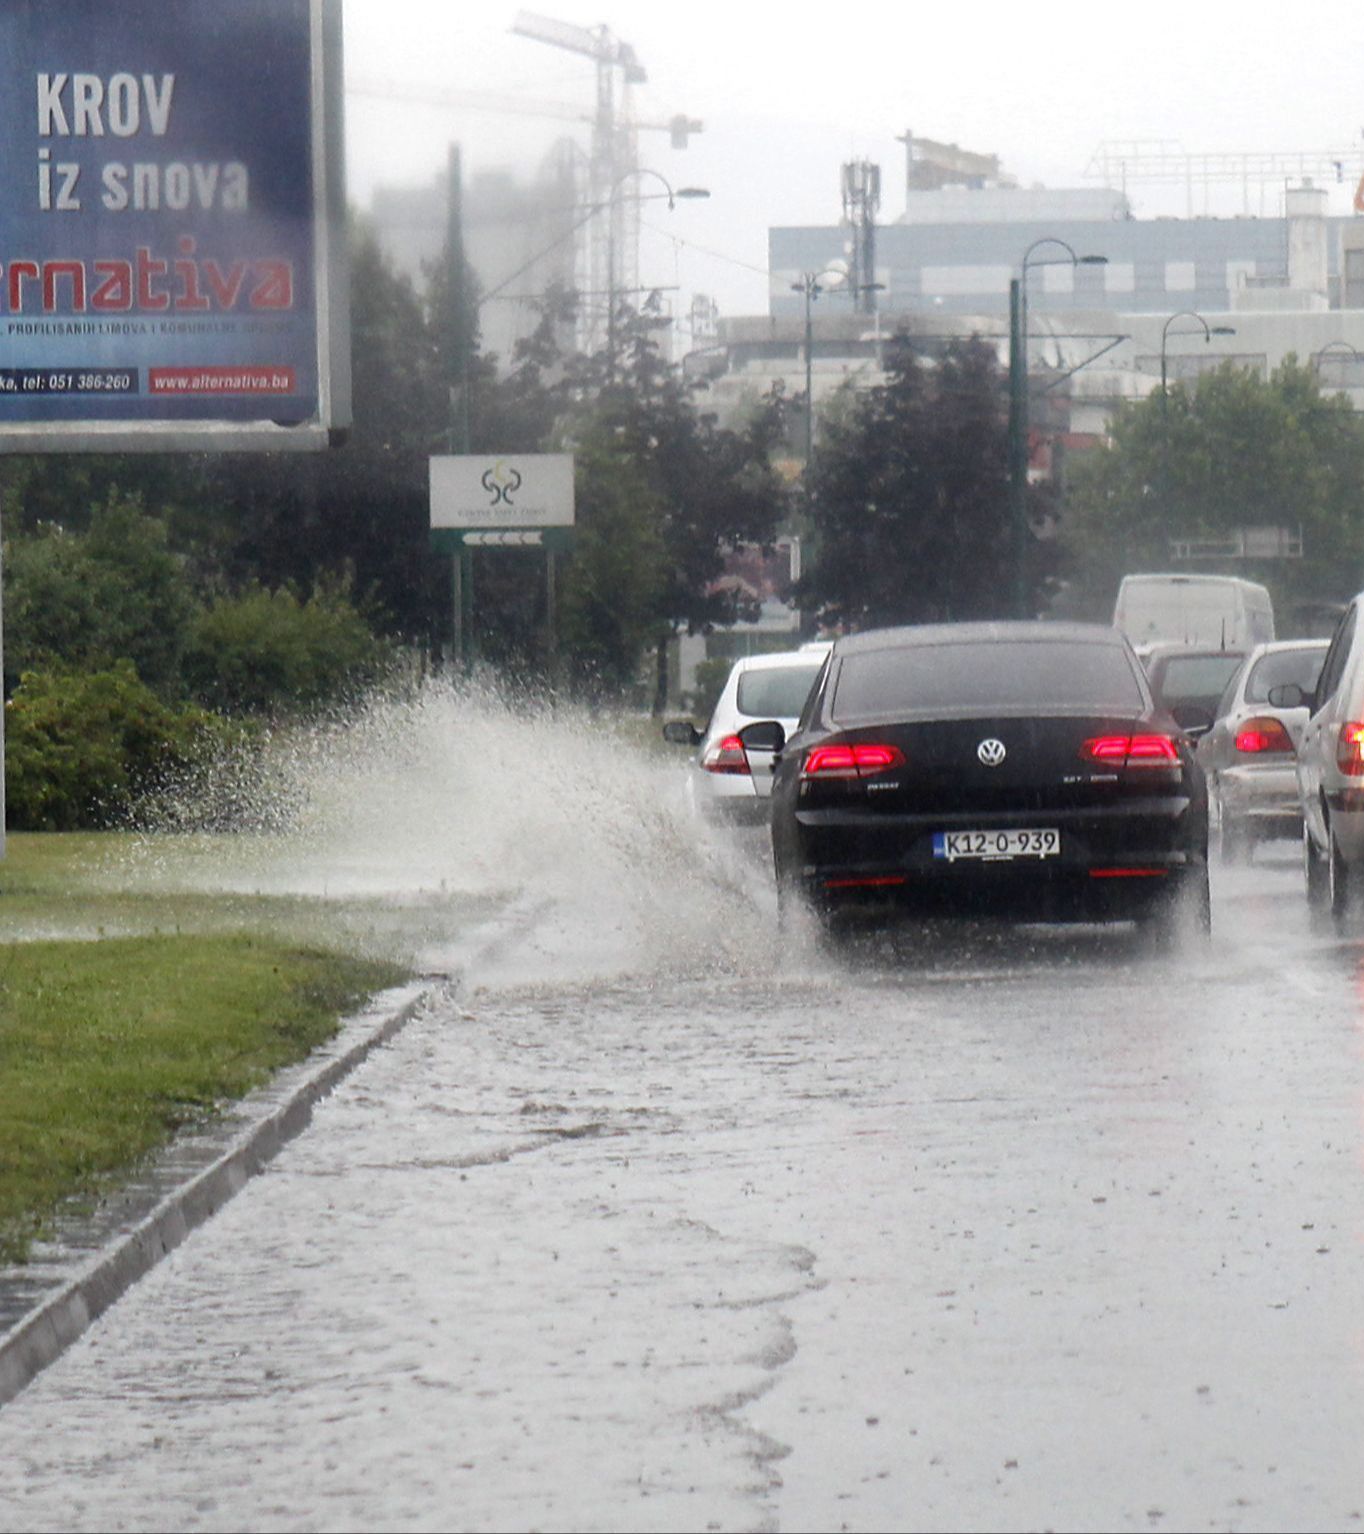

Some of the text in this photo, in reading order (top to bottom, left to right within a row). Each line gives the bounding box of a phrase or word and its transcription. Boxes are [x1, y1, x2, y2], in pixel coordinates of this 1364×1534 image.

[37, 73, 176, 137] KROV
[38, 149, 250, 211] iz snova
[0, 236, 294, 312] rnativa
[8, 322, 95, 336] PROFILISANIH
[99, 322, 147, 336] LIMOVA
[23, 374, 45, 390] tel:
[49, 374, 73, 390] 051
[78, 374, 130, 390] 386-260
[154, 375, 290, 390] www.alternativa.ba
